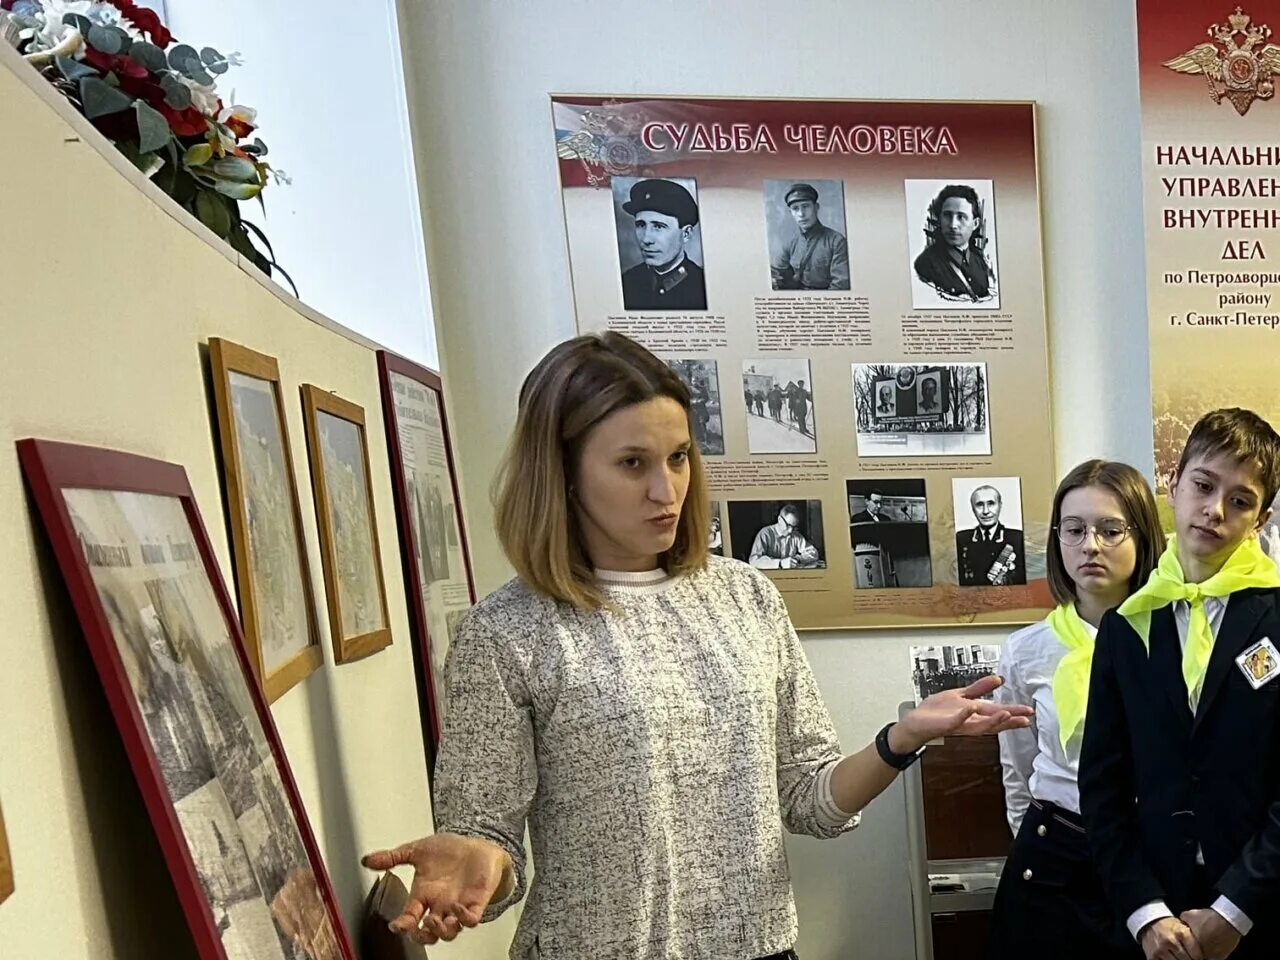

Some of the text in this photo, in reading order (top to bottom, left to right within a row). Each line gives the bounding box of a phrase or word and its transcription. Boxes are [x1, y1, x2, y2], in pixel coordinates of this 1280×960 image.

[642, 121, 958, 156] СУДЬБА ЧЕЛОВЕКА
[1220, 239, 1267, 261] ДЕЛ
[1164, 272, 1183, 285] по
[1218, 291, 1272, 309] району
[1170, 315, 1182, 327] г.
